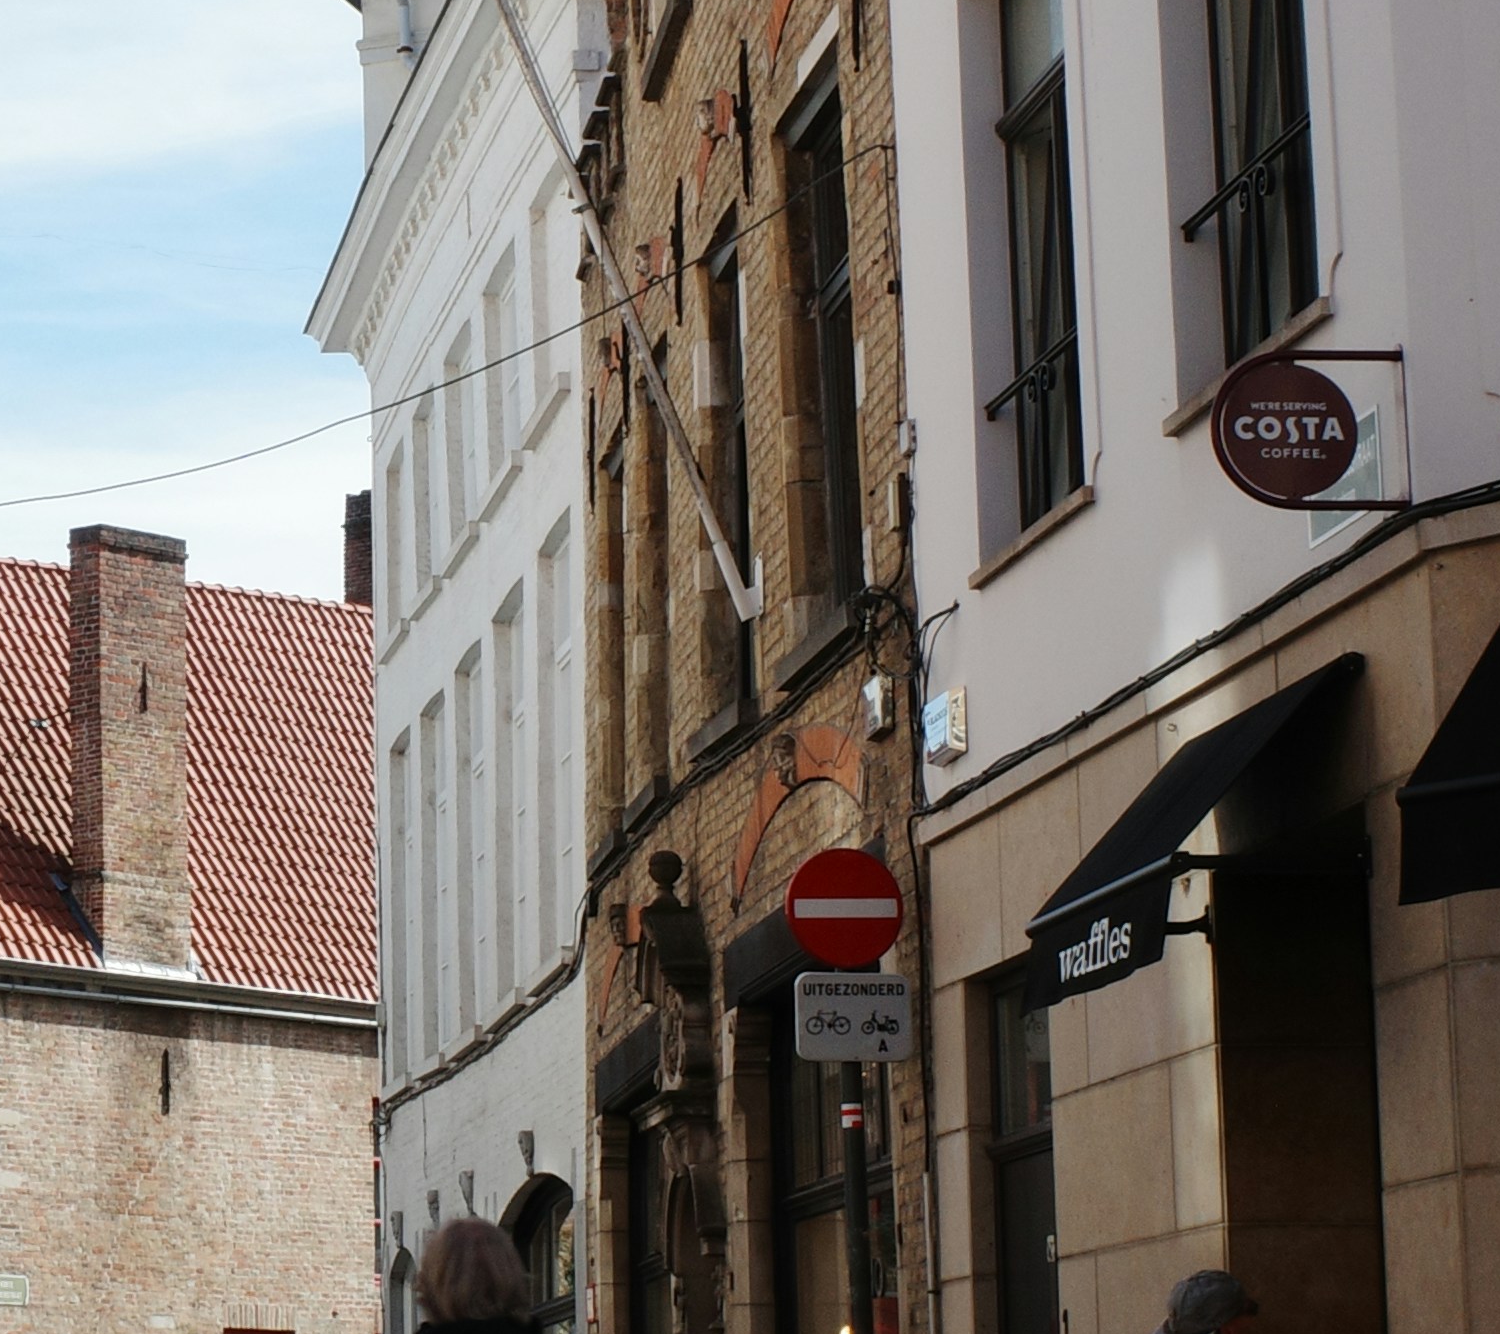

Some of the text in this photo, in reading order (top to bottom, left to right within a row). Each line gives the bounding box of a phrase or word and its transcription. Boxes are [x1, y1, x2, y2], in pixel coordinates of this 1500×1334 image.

[1283, 401, 1327, 411] SERVING
[1233, 415, 1345, 444] COSTA
[1057, 916, 1132, 984] waffles
[803, 982, 905, 997] UITGEZONDERD
[878, 1039, 889, 1053] A
